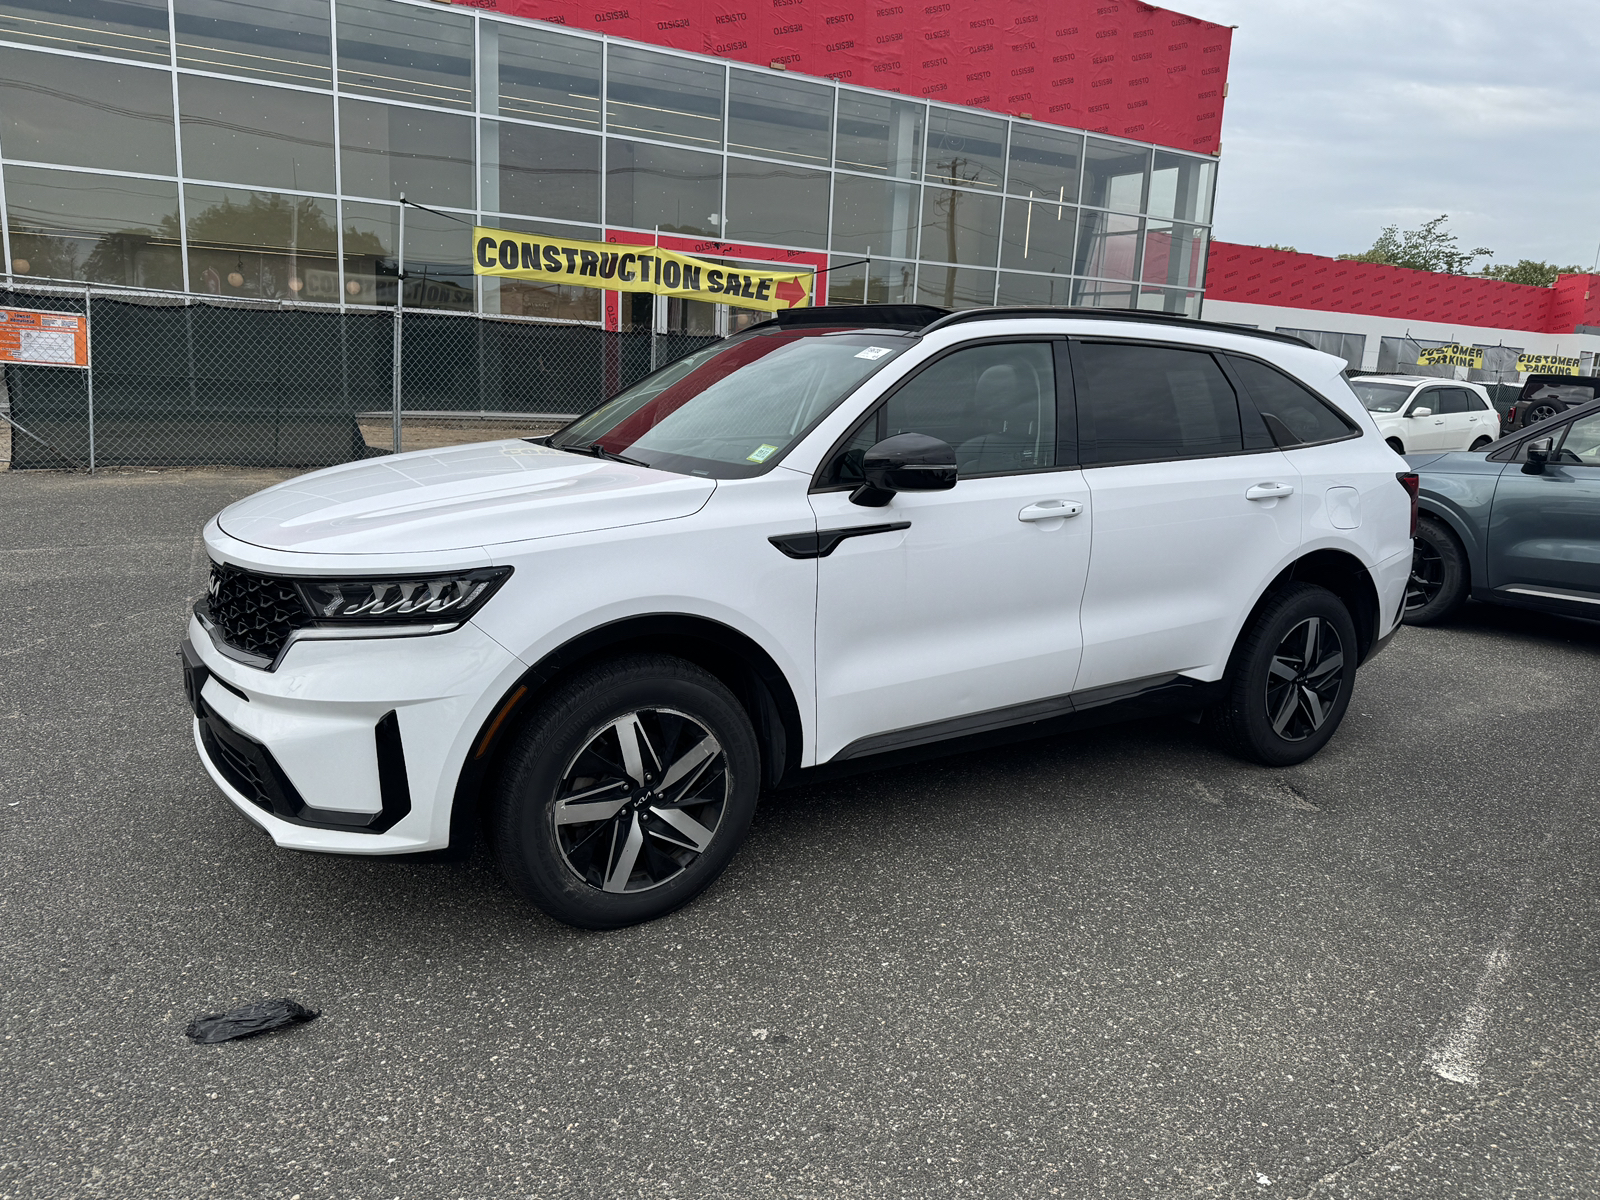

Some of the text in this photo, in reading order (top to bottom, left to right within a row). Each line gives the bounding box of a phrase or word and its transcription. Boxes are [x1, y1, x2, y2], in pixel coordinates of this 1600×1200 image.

[876, 6, 904, 17] RESISTO
[925, 4, 950, 14] RESISTO
[1097, 6, 1118, 14] RESISTO
[595, 10, 631, 22] RESISTO
[715, 12, 747, 24] RESISTO
[826, 14, 854, 24] RESISTO
[1015, 15, 1038, 25] RESISTO
[657, 18, 690, 30] RESISTO
[970, 18, 994, 28] RESISTO
[773, 24, 803, 35] RESISTO
[1056, 27, 1078, 37] RESISTO
[1096, 29, 1118, 38] RESISTO
[1133, 29, 1154, 38] RESISTO
[876, 33, 903, 44] RESISTO
[925, 30, 950, 41] RESISTO
[716, 41, 748, 53] RESISTO
[826, 40, 854, 52] RESISTO
[970, 44, 994, 54] RESISTO
[1012, 42, 1036, 52] RESISTO
[1168, 42, 1188, 52] RESISTO
[1203, 44, 1222, 54] RESISTO
[1052, 53, 1075, 63] RESISTO
[1092, 54, 1114, 64] RESISTO
[1132, 52, 1152, 62] RESISTO
[874, 61, 900, 72] RESISTO
[922, 58, 948, 68] RESISTO
[966, 71, 991, 82] RESISTO
[1011, 66, 1034, 76] RESISTO
[1052, 77, 1074, 88] RESISTO
[1092, 78, 1112, 88] RESISTO
[1128, 76, 1150, 87] RESISTO
[922, 83, 948, 94] RESISTO
[966, 95, 990, 106] RESISTO
[1008, 92, 1032, 103] RESISTO
[1198, 90, 1217, 100] RESISTO
[1049, 102, 1072, 113] RESISTO
[1088, 103, 1110, 113] RESISTO
[1127, 100, 1148, 110] RESISTO
[1124, 124, 1144, 134] RESISTO
[477, 236, 774, 302] CONSTRUCTION SALE
[1420, 344, 1483, 358] CUSTOMER
[1425, 354, 1475, 367] PARKING
[1518, 354, 1580, 367] CUSTOMER
[1523, 364, 1572, 375] PARKING
[551, 697, 612, 755] Continental
